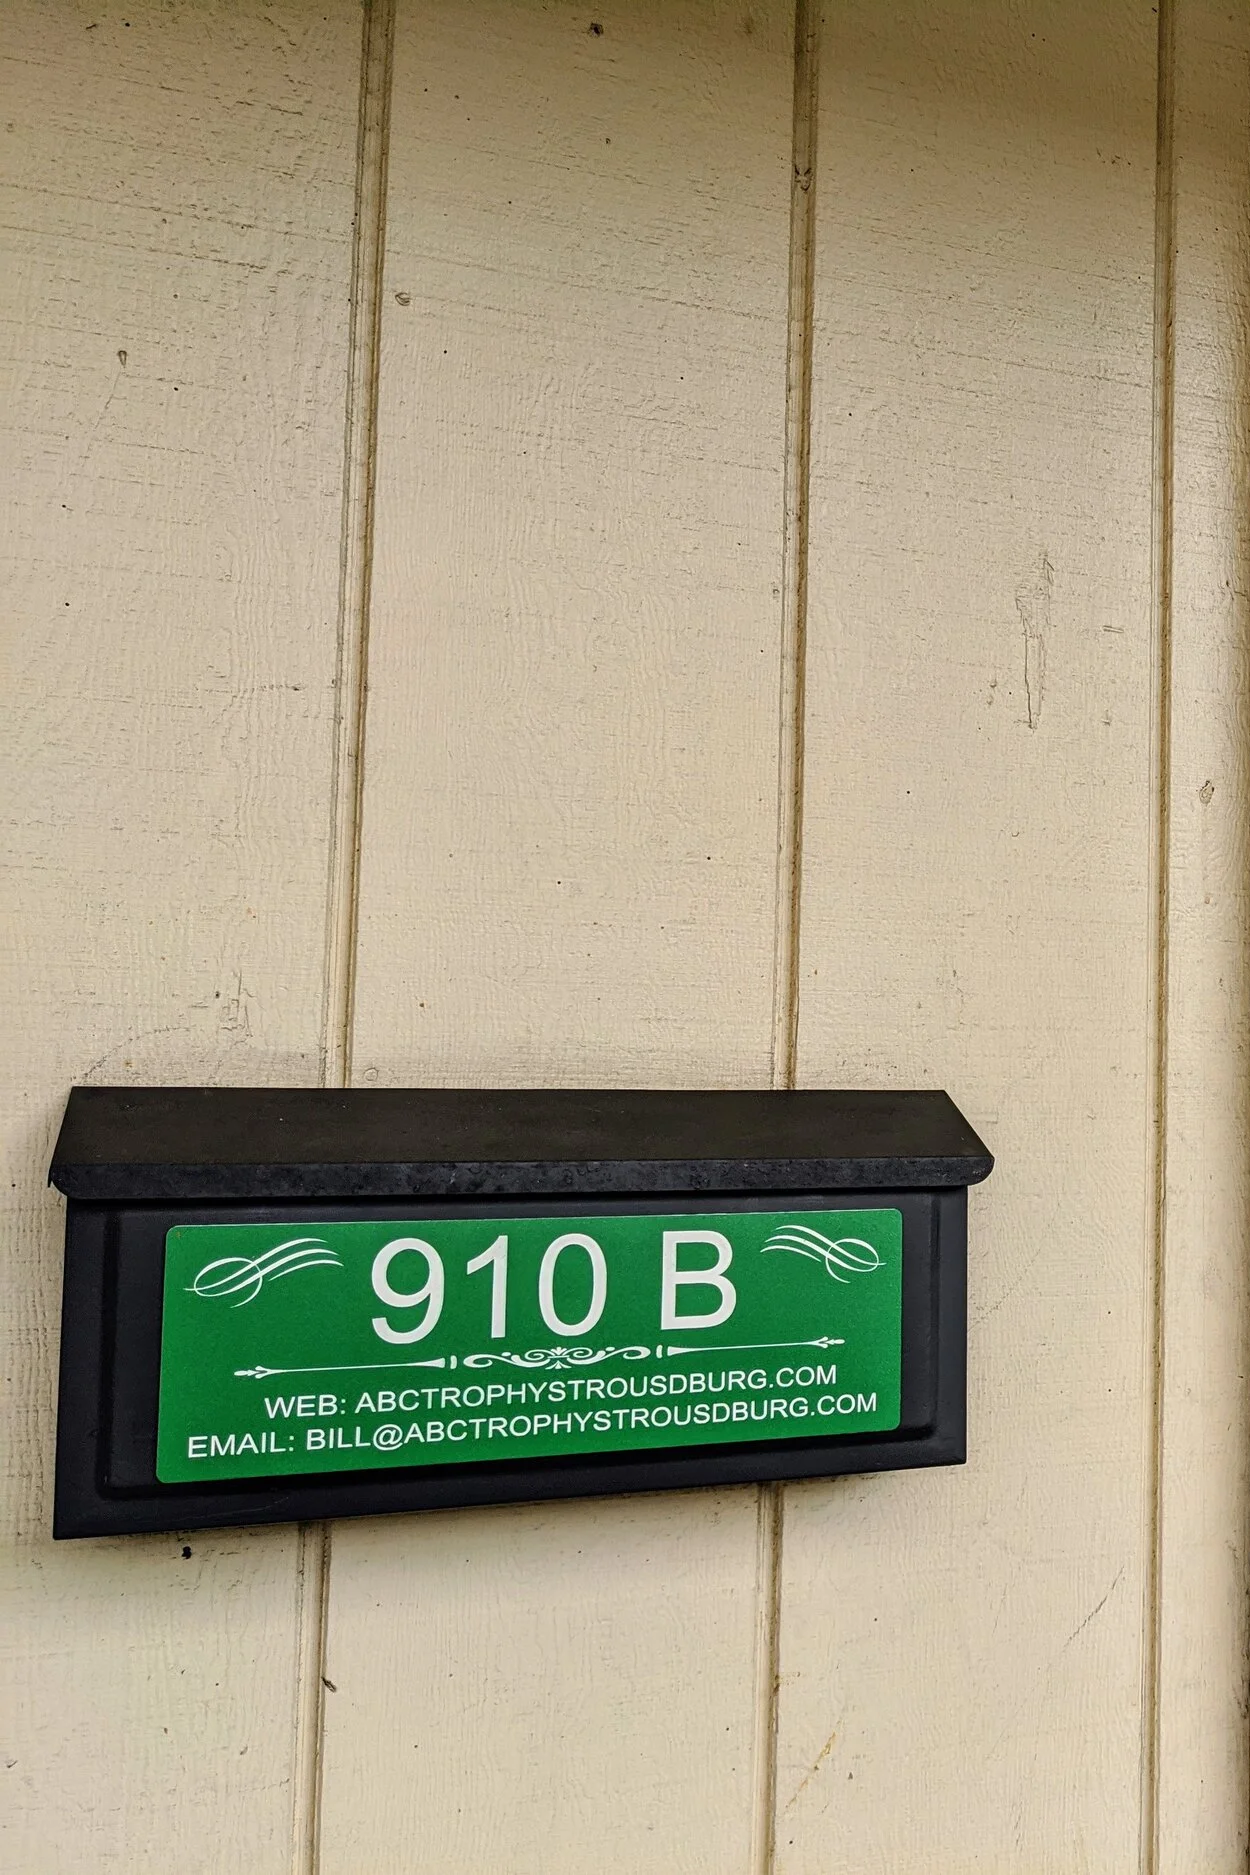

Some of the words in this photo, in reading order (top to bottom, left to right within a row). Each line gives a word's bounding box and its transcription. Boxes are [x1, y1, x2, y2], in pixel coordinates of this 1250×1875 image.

[371, 1232, 609, 1345] 910
[660, 1230, 738, 1331] B
[187, 1430, 296, 1459] EMAIL:
[305, 1392, 878, 1452] BILL@ABCTROPHYSTROUSDBURG.COM
[264, 1393, 348, 1420] WEB:
[354, 1364, 838, 1414] ABCTROPHYSTROUSDBURG.COM
